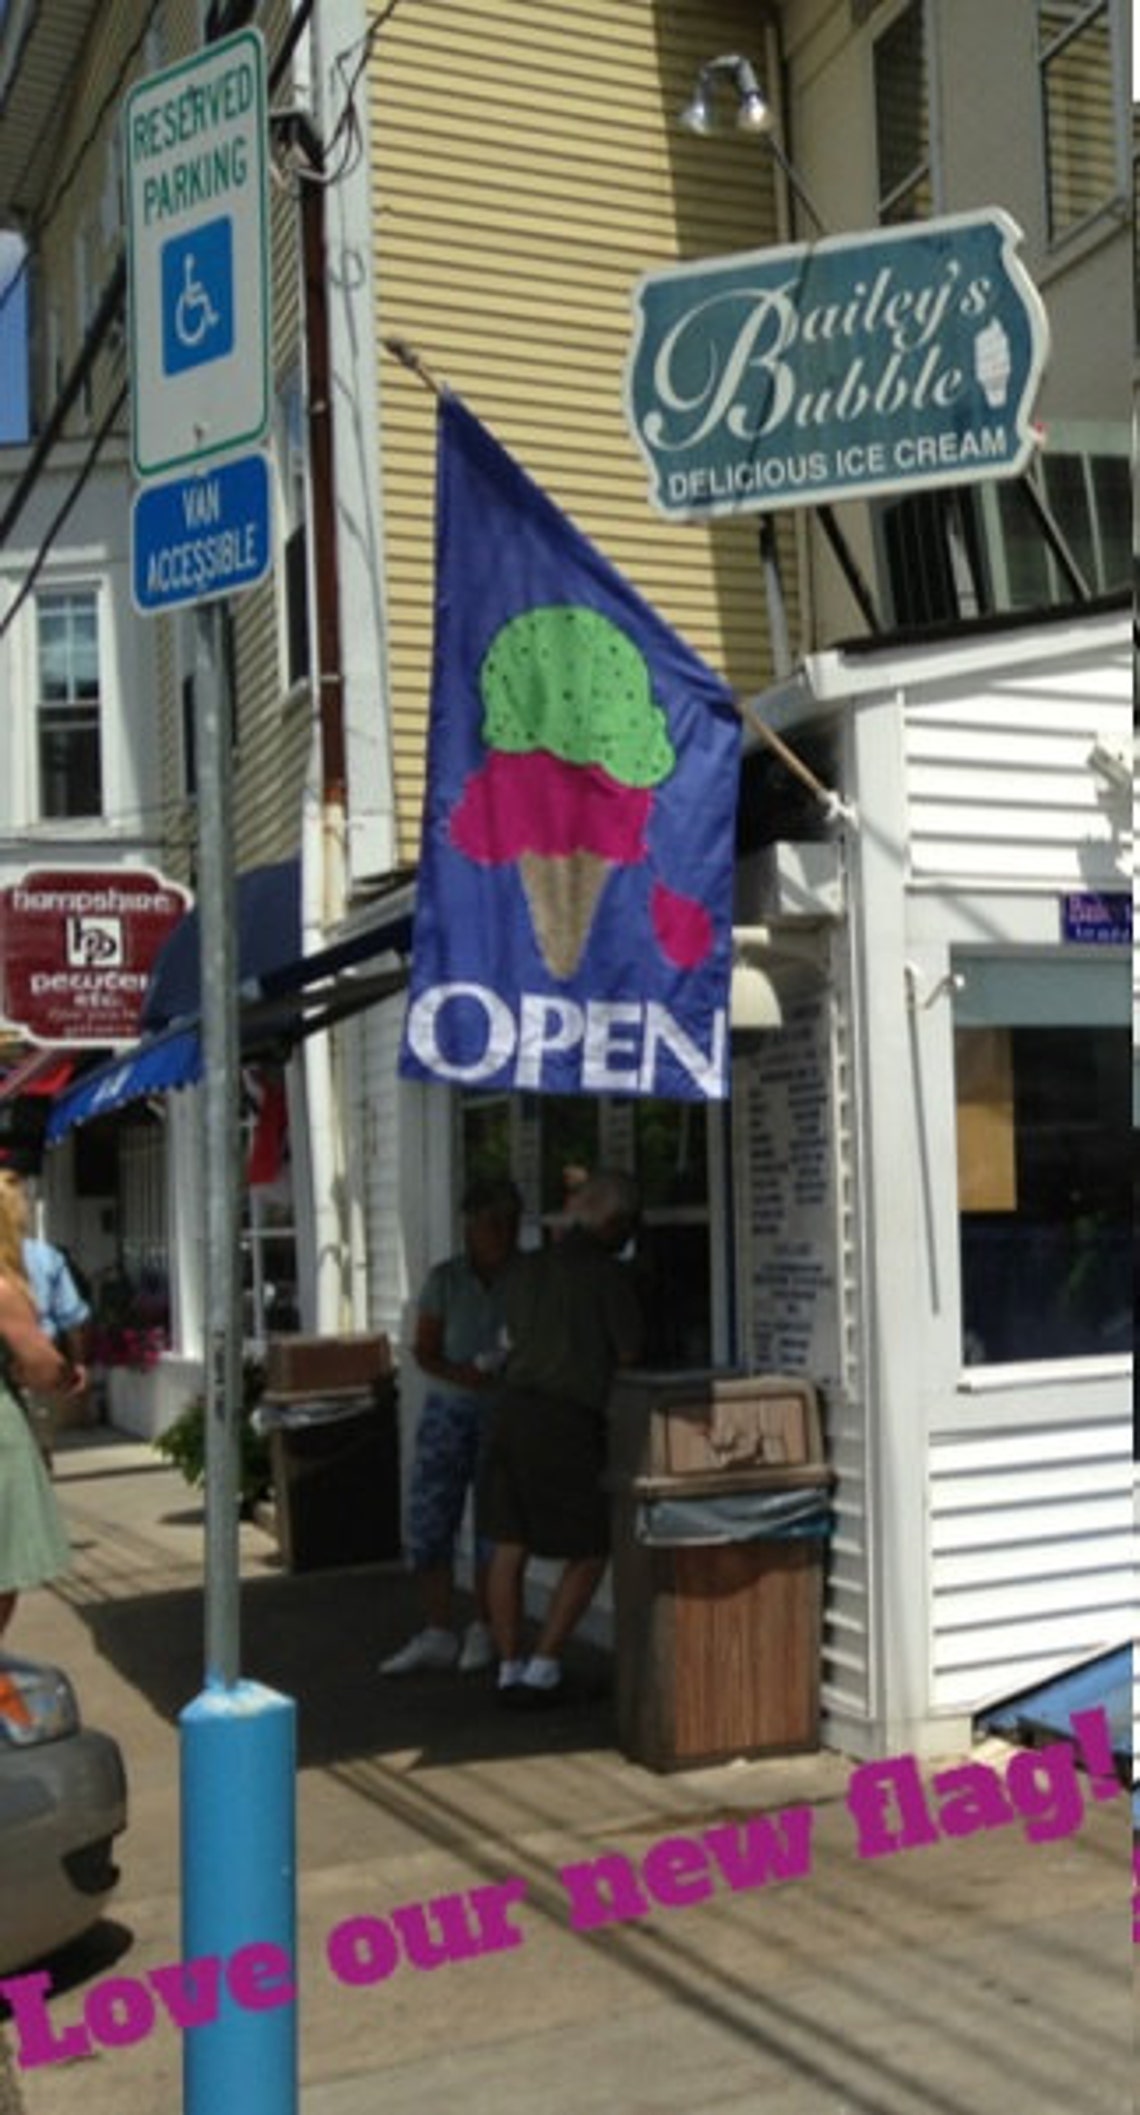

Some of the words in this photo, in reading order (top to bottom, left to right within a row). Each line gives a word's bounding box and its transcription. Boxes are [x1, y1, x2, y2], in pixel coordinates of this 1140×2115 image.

[131, 62, 252, 162] RESERVED
[143, 136, 247, 227] PARKING
[643, 260, 991, 450] Bailey's
[181, 484, 221, 530] VAN
[668, 451, 828, 500] DELICIOUS
[836, 442, 885, 474] ICE
[894, 426, 1007, 465] CREAM
[146, 523, 258, 592] ACCESSIBLE
[407, 981, 726, 1099] OPEN
